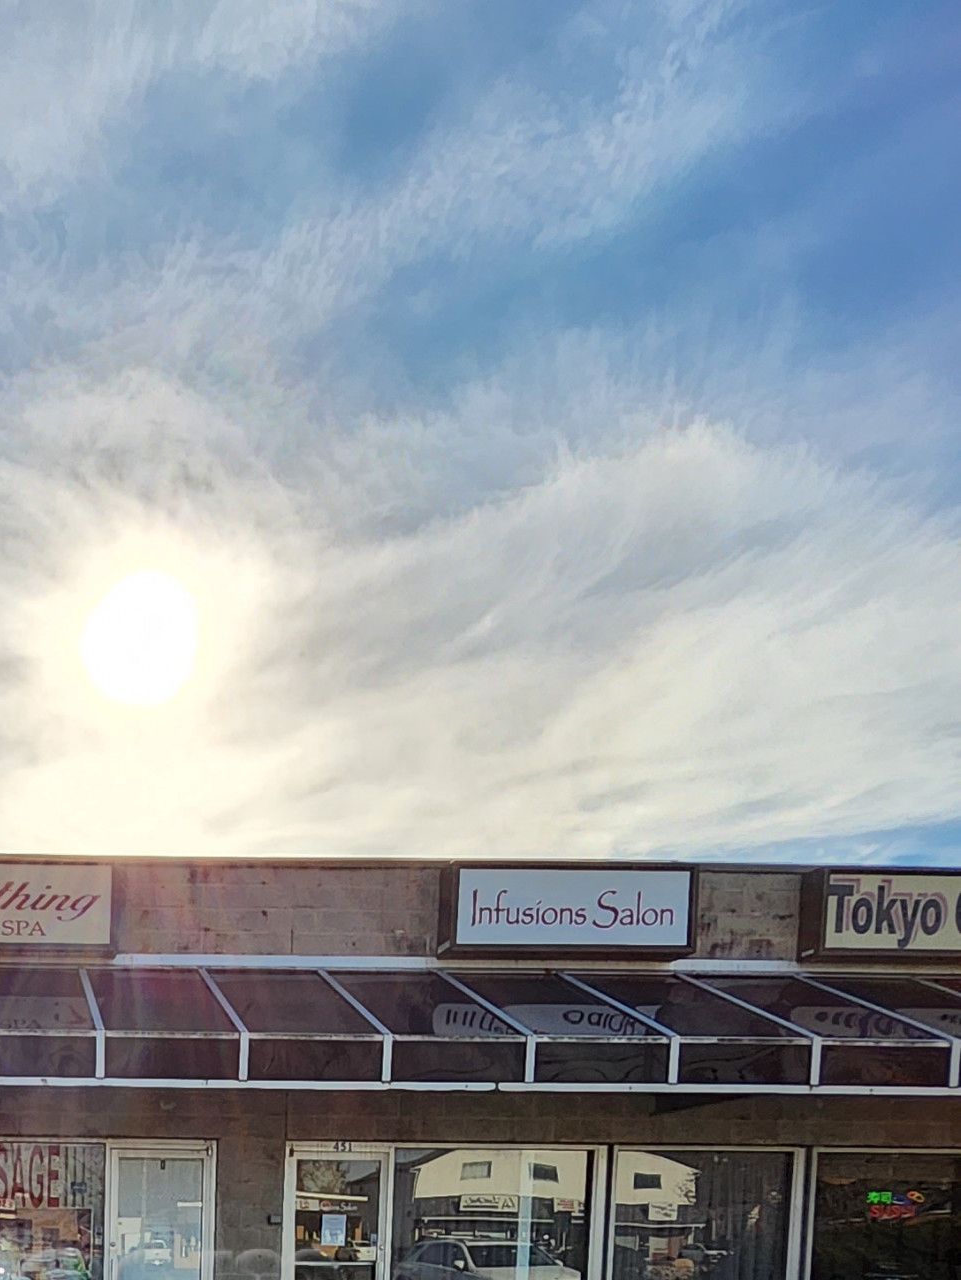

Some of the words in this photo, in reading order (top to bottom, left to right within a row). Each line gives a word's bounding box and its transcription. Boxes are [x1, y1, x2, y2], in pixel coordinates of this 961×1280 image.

[1, 919, 47, 937] SPA
[471, 888, 587, 927] Infusions
[592, 889, 675, 928] Salon
[829, 879, 946, 949] Tokyo
